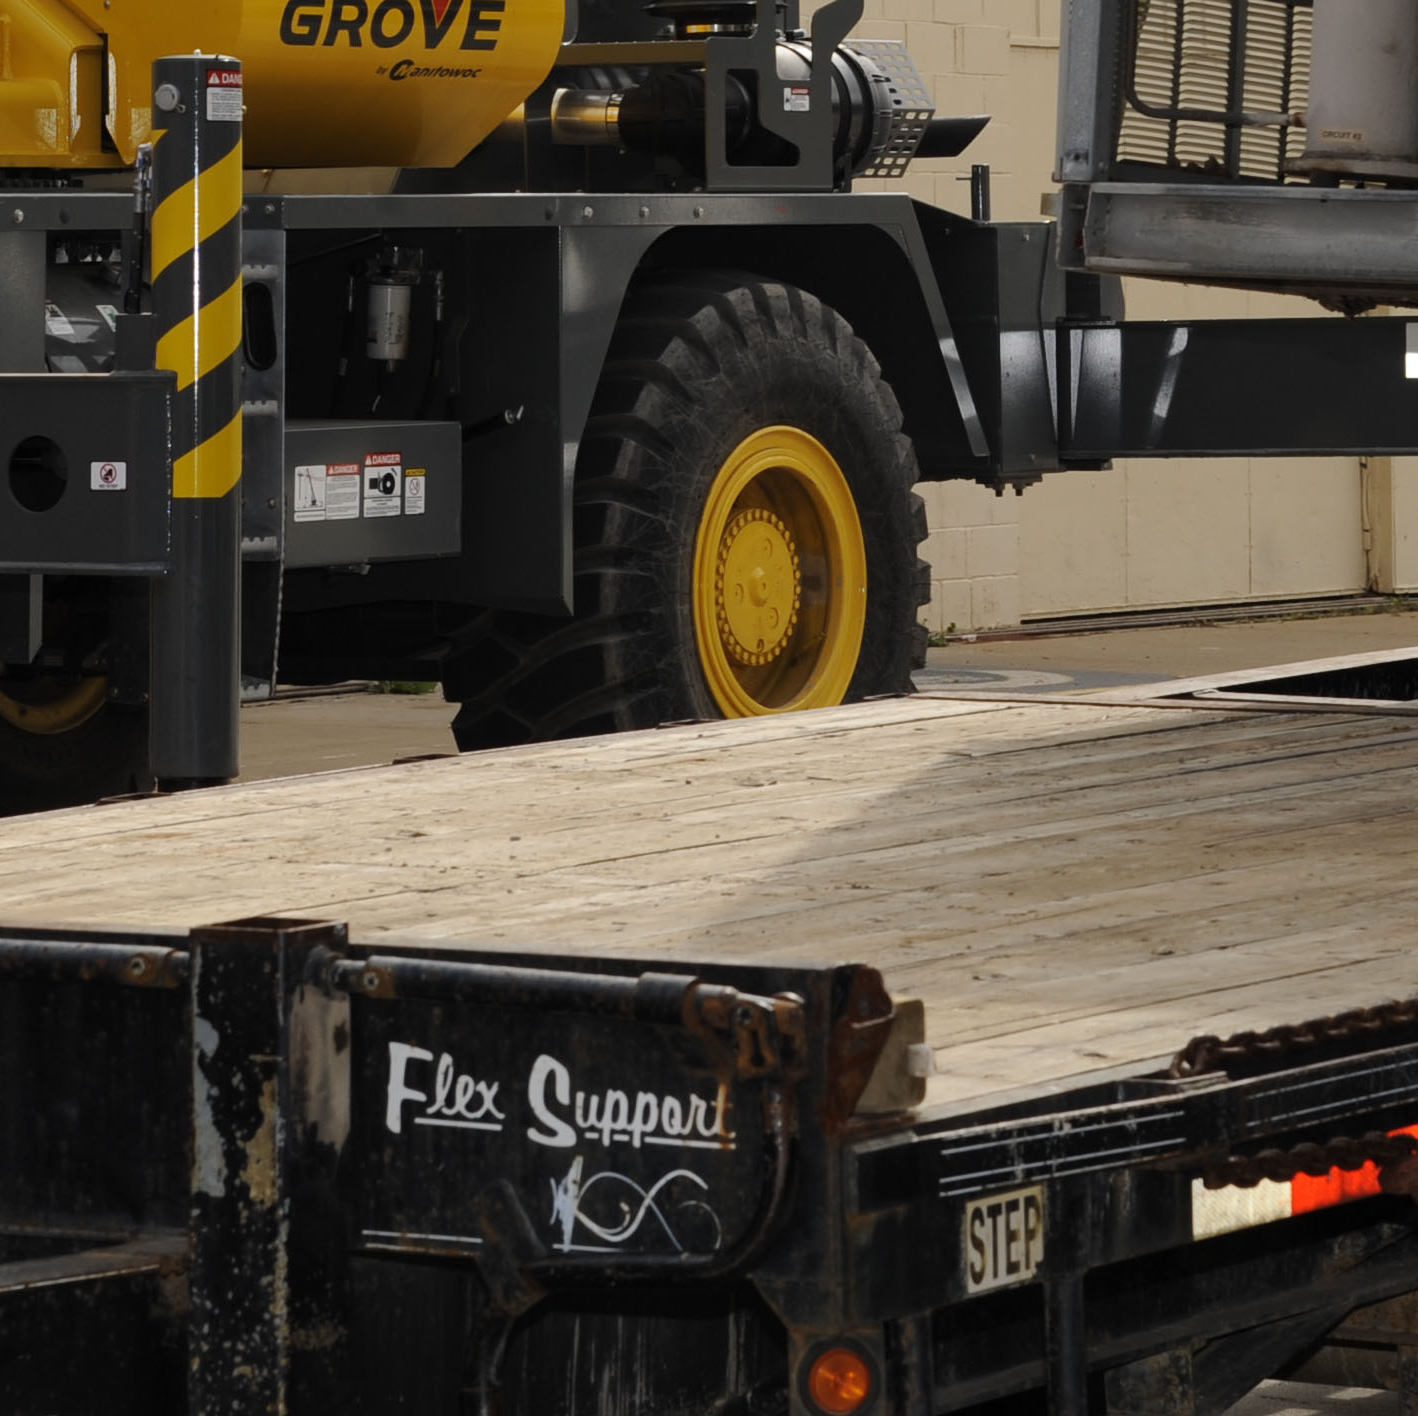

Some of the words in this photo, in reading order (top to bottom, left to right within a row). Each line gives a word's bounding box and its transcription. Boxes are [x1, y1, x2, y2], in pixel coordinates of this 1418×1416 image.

[389, 59, 483, 81] Manitowoc
[372, 454, 401, 464] DANGER
[385, 1041, 506, 1134] Flex
[527, 1054, 737, 1148] Support
[970, 1195, 1042, 1286] STEP
